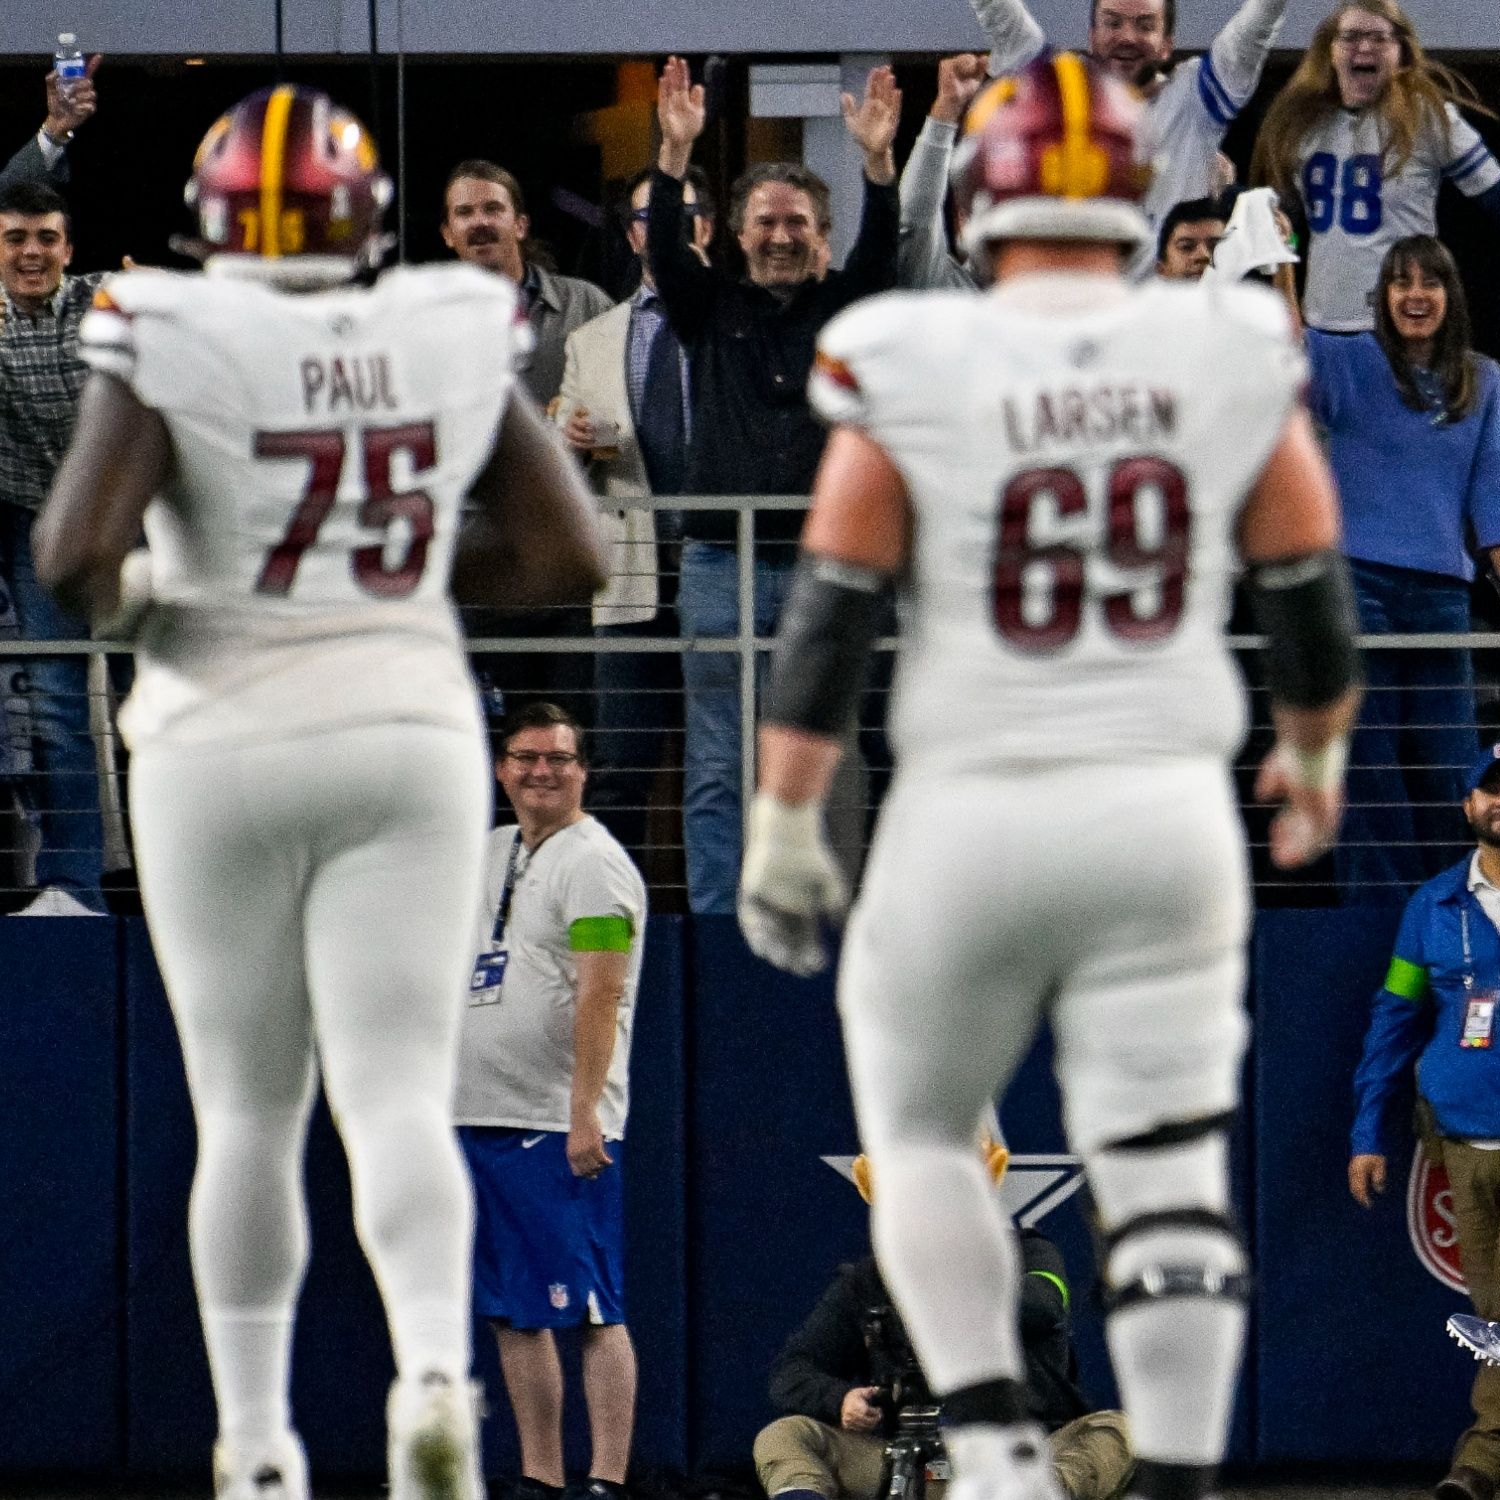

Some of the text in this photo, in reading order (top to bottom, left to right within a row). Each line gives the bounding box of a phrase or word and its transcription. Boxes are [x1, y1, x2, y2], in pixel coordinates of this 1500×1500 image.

[1303, 151, 1382, 235] 88
[301, 354, 398, 411] PAUL
[1001, 384, 1177, 453] LARSEN
[252, 419, 437, 599] 75
[992, 455, 1190, 653] 69
